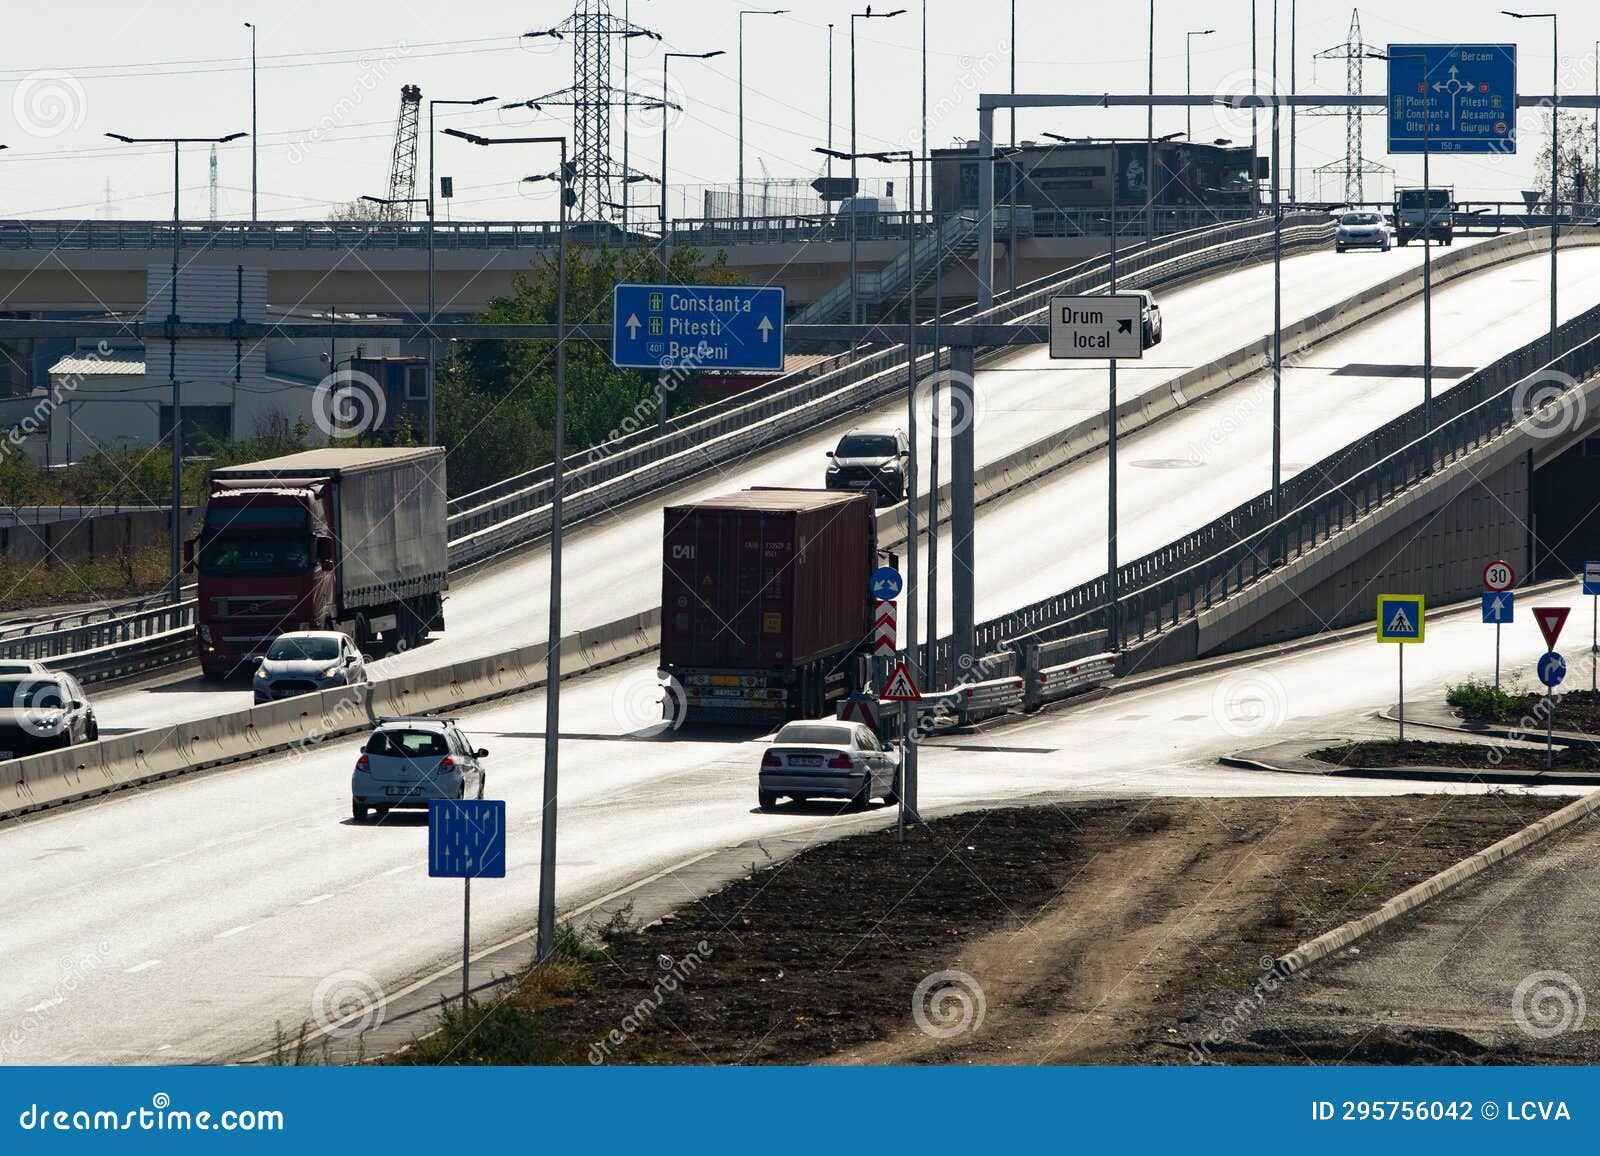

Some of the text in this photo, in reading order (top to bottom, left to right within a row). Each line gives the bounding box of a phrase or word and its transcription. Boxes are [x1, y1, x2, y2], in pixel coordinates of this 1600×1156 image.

[1460, 97, 1488, 107] Pitesti
[1461, 110, 1505, 119] Alexandria
[1460, 122, 1490, 134] Giurgiu
[670, 294, 751, 312] Constanta
[1062, 306, 1103, 324] Drum
[670, 317, 721, 336] Pitesti
[1074, 331, 1110, 348] local
[669, 341, 728, 360] Berceni
[672, 545, 695, 559] CAI
[1490, 568, 1506, 583] 30
